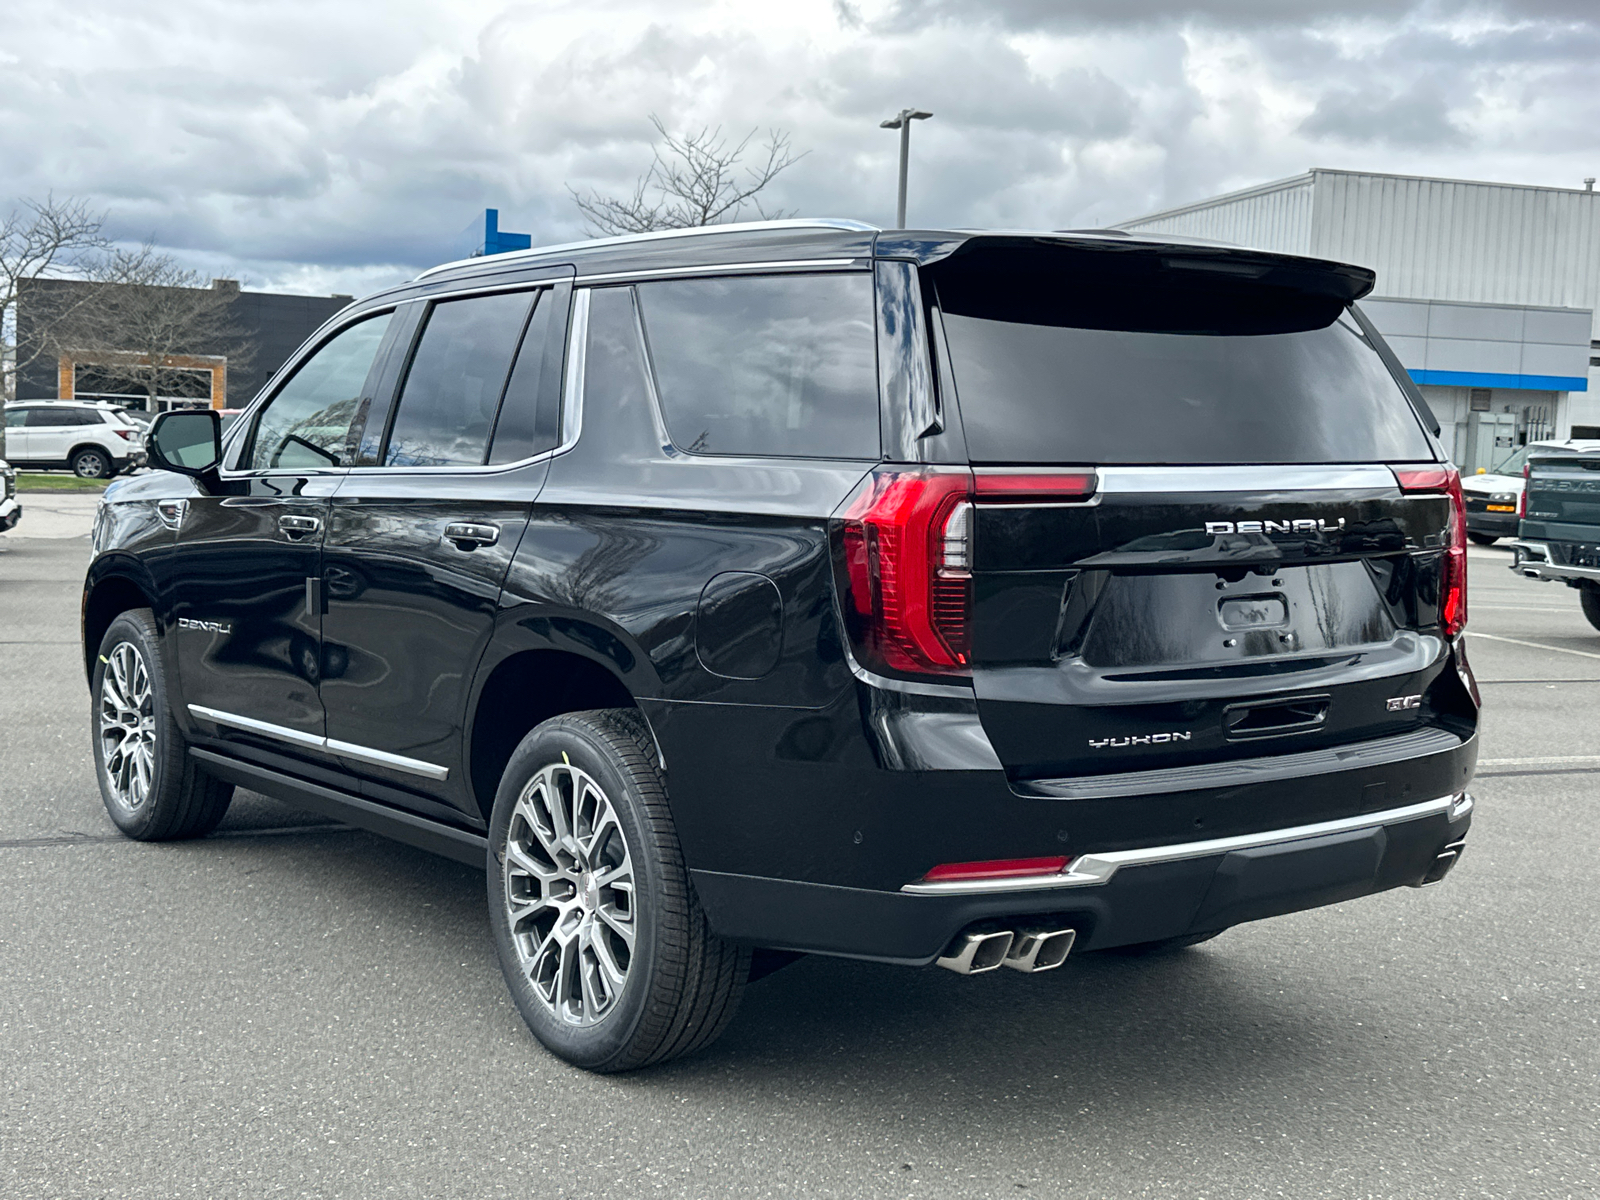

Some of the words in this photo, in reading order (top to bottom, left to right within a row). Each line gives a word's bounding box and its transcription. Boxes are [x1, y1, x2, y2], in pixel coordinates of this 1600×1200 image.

[1205, 517, 1345, 536] DENALI
[178, 617, 231, 634] DENALI
[1088, 731, 1191, 748] YUKON
